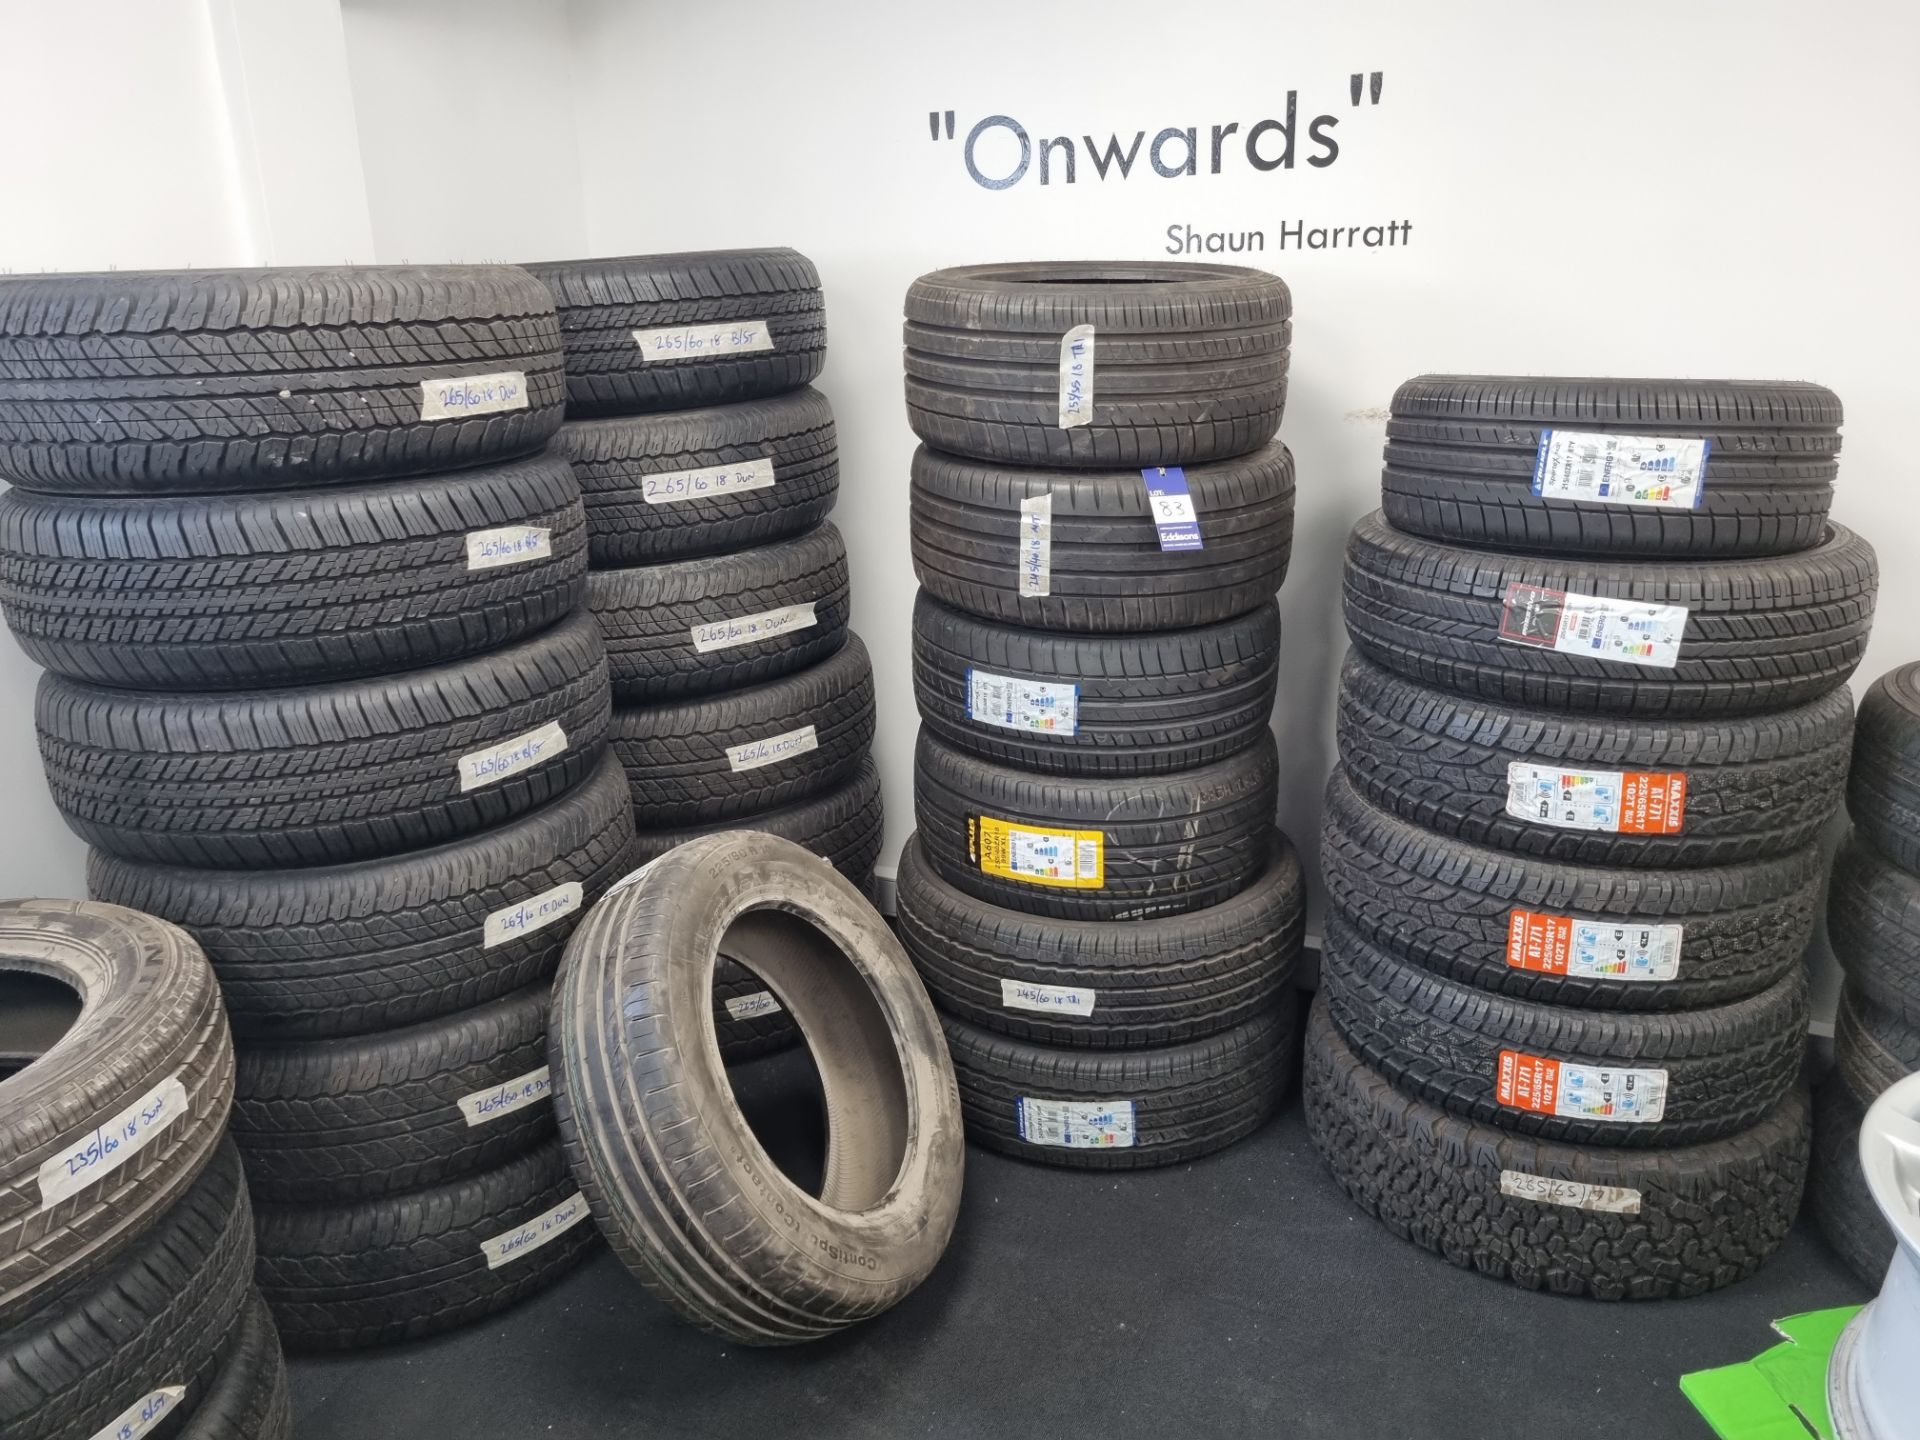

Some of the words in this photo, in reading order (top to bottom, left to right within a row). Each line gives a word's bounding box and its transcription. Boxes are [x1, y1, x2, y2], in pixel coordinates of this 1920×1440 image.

[1165, 224, 1265, 254] Shaun
[1280, 219, 1413, 250] Harratt
[655, 329, 704, 352] 265/60
[710, 334, 722, 348] 18
[1071, 363, 1084, 376] 18
[440, 382, 481, 409] 265/60
[483, 388, 493, 401] 18
[647, 473, 708, 497] 265/60
[716, 474, 727, 487] 18
[1158, 501, 1185, 517] 83
[478, 535, 512, 558] 265/60
[513, 539, 522, 553] 18
[1030, 539, 1041, 550] 18
[1160, 532, 1200, 542] Eddisons
[697, 620, 742, 643] 265/60
[747, 623, 758, 633] 18
[472, 751, 510, 778] 265/60
[736, 742, 770, 763] 265/60
[772, 743, 782, 754] 18
[1626, 781, 1637, 808] 102T
[1635, 776, 1649, 831] 225/65R17
[1649, 787, 1664, 821] AT-771
[1668, 779, 1682, 828] MAXXIS
[983, 831, 992, 861] A607
[1511, 915, 1525, 961] MAXXIS
[1529, 926, 1544, 958] AT-771
[1543, 918, 1556, 970] 225/65R17
[1555, 943, 1564, 966] 102T
[1016, 988, 1050, 1006] 245/60
[1501, 1055, 1514, 1100] MAXXIS
[1517, 1066, 1532, 1098] AT-771
[1532, 1060, 1545, 1110] 225/65R17
[475, 1087, 518, 1114] 265/60
[522, 1083, 532, 1097] 18
[1543, 1084, 1554, 1106] 102T
[65, 1127, 120, 1176] 235/60
[122, 1121, 137, 1146] 18
[500, 1229, 537, 1255] 265/60
[117, 1423, 132, 1440] 18
